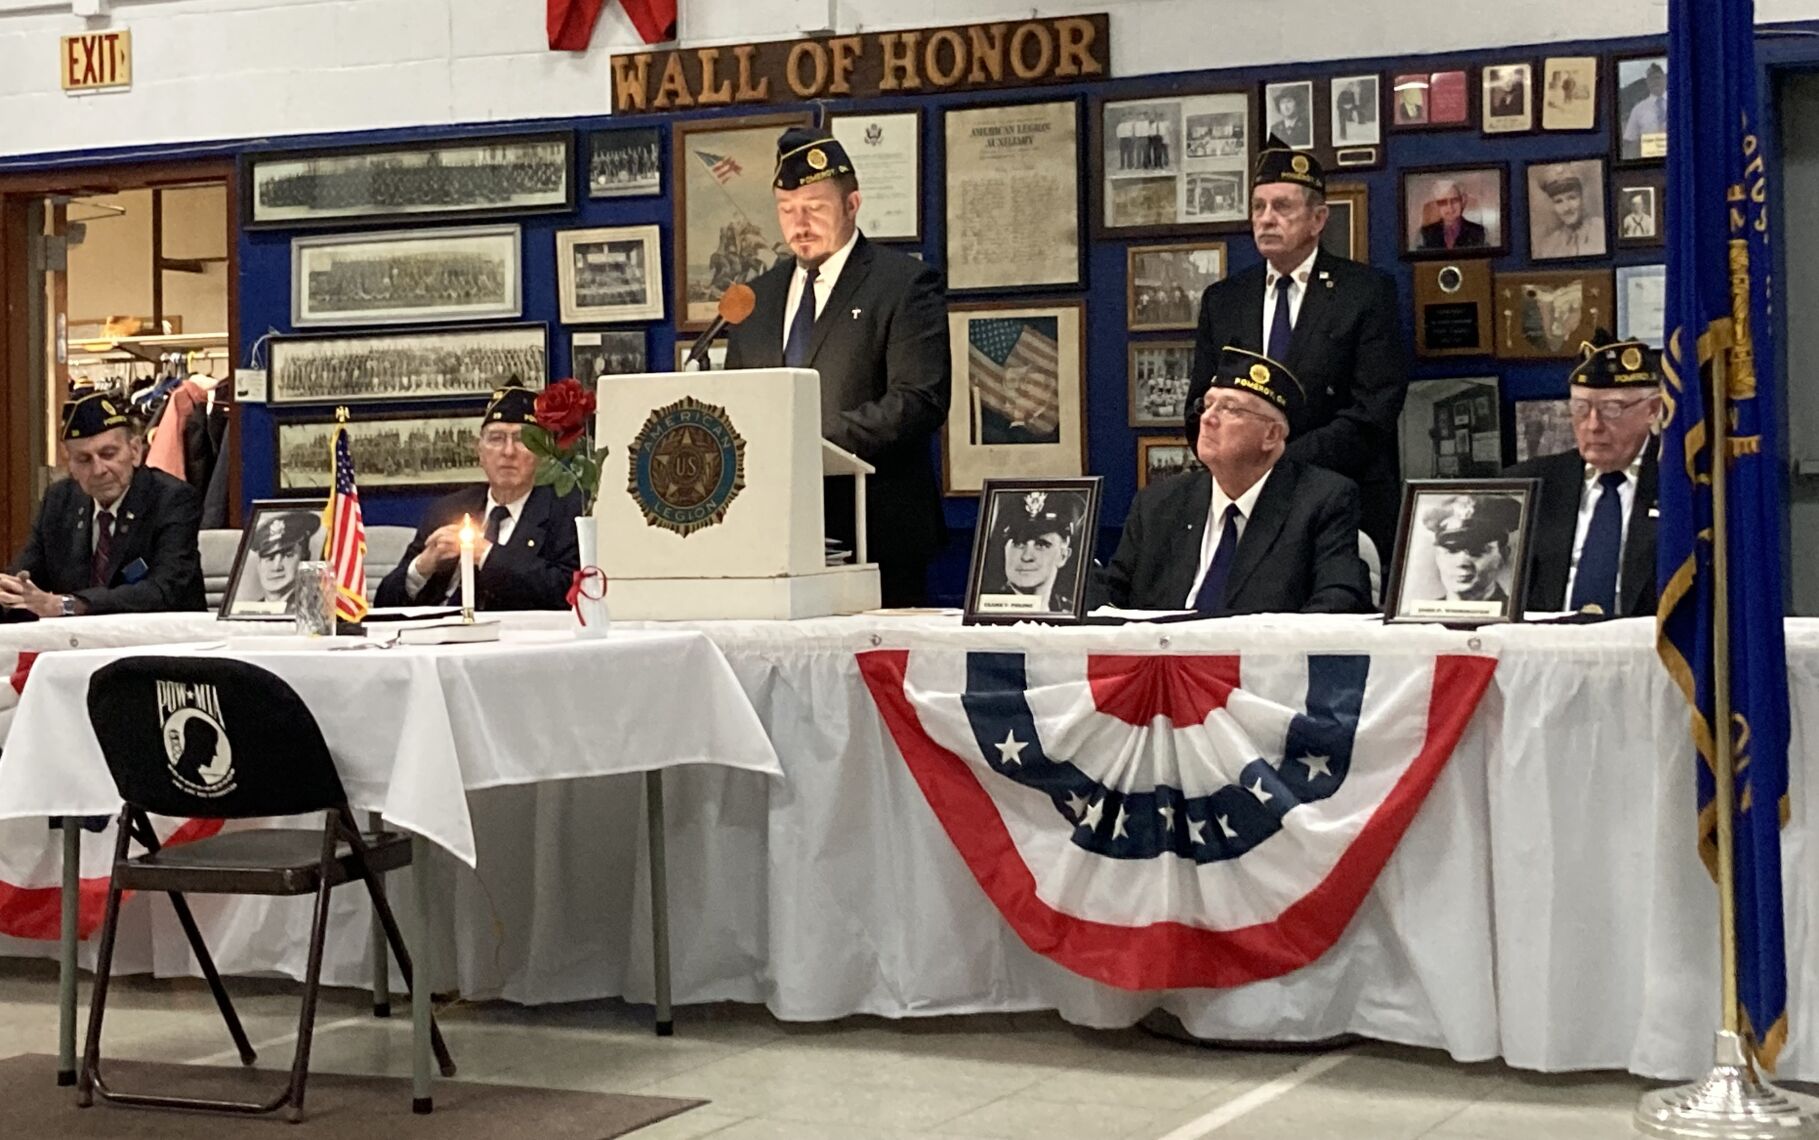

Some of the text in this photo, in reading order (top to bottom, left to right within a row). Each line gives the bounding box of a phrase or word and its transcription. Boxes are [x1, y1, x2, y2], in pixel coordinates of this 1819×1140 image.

[68, 33, 119, 85] EXIT
[612, 18, 1102, 111] WALL OF HONOR
[643, 410, 732, 453] AMERICAN
[676, 456, 697, 476] US
[654, 501, 718, 521] LEGION
[156, 680, 226, 730] POW MIA
